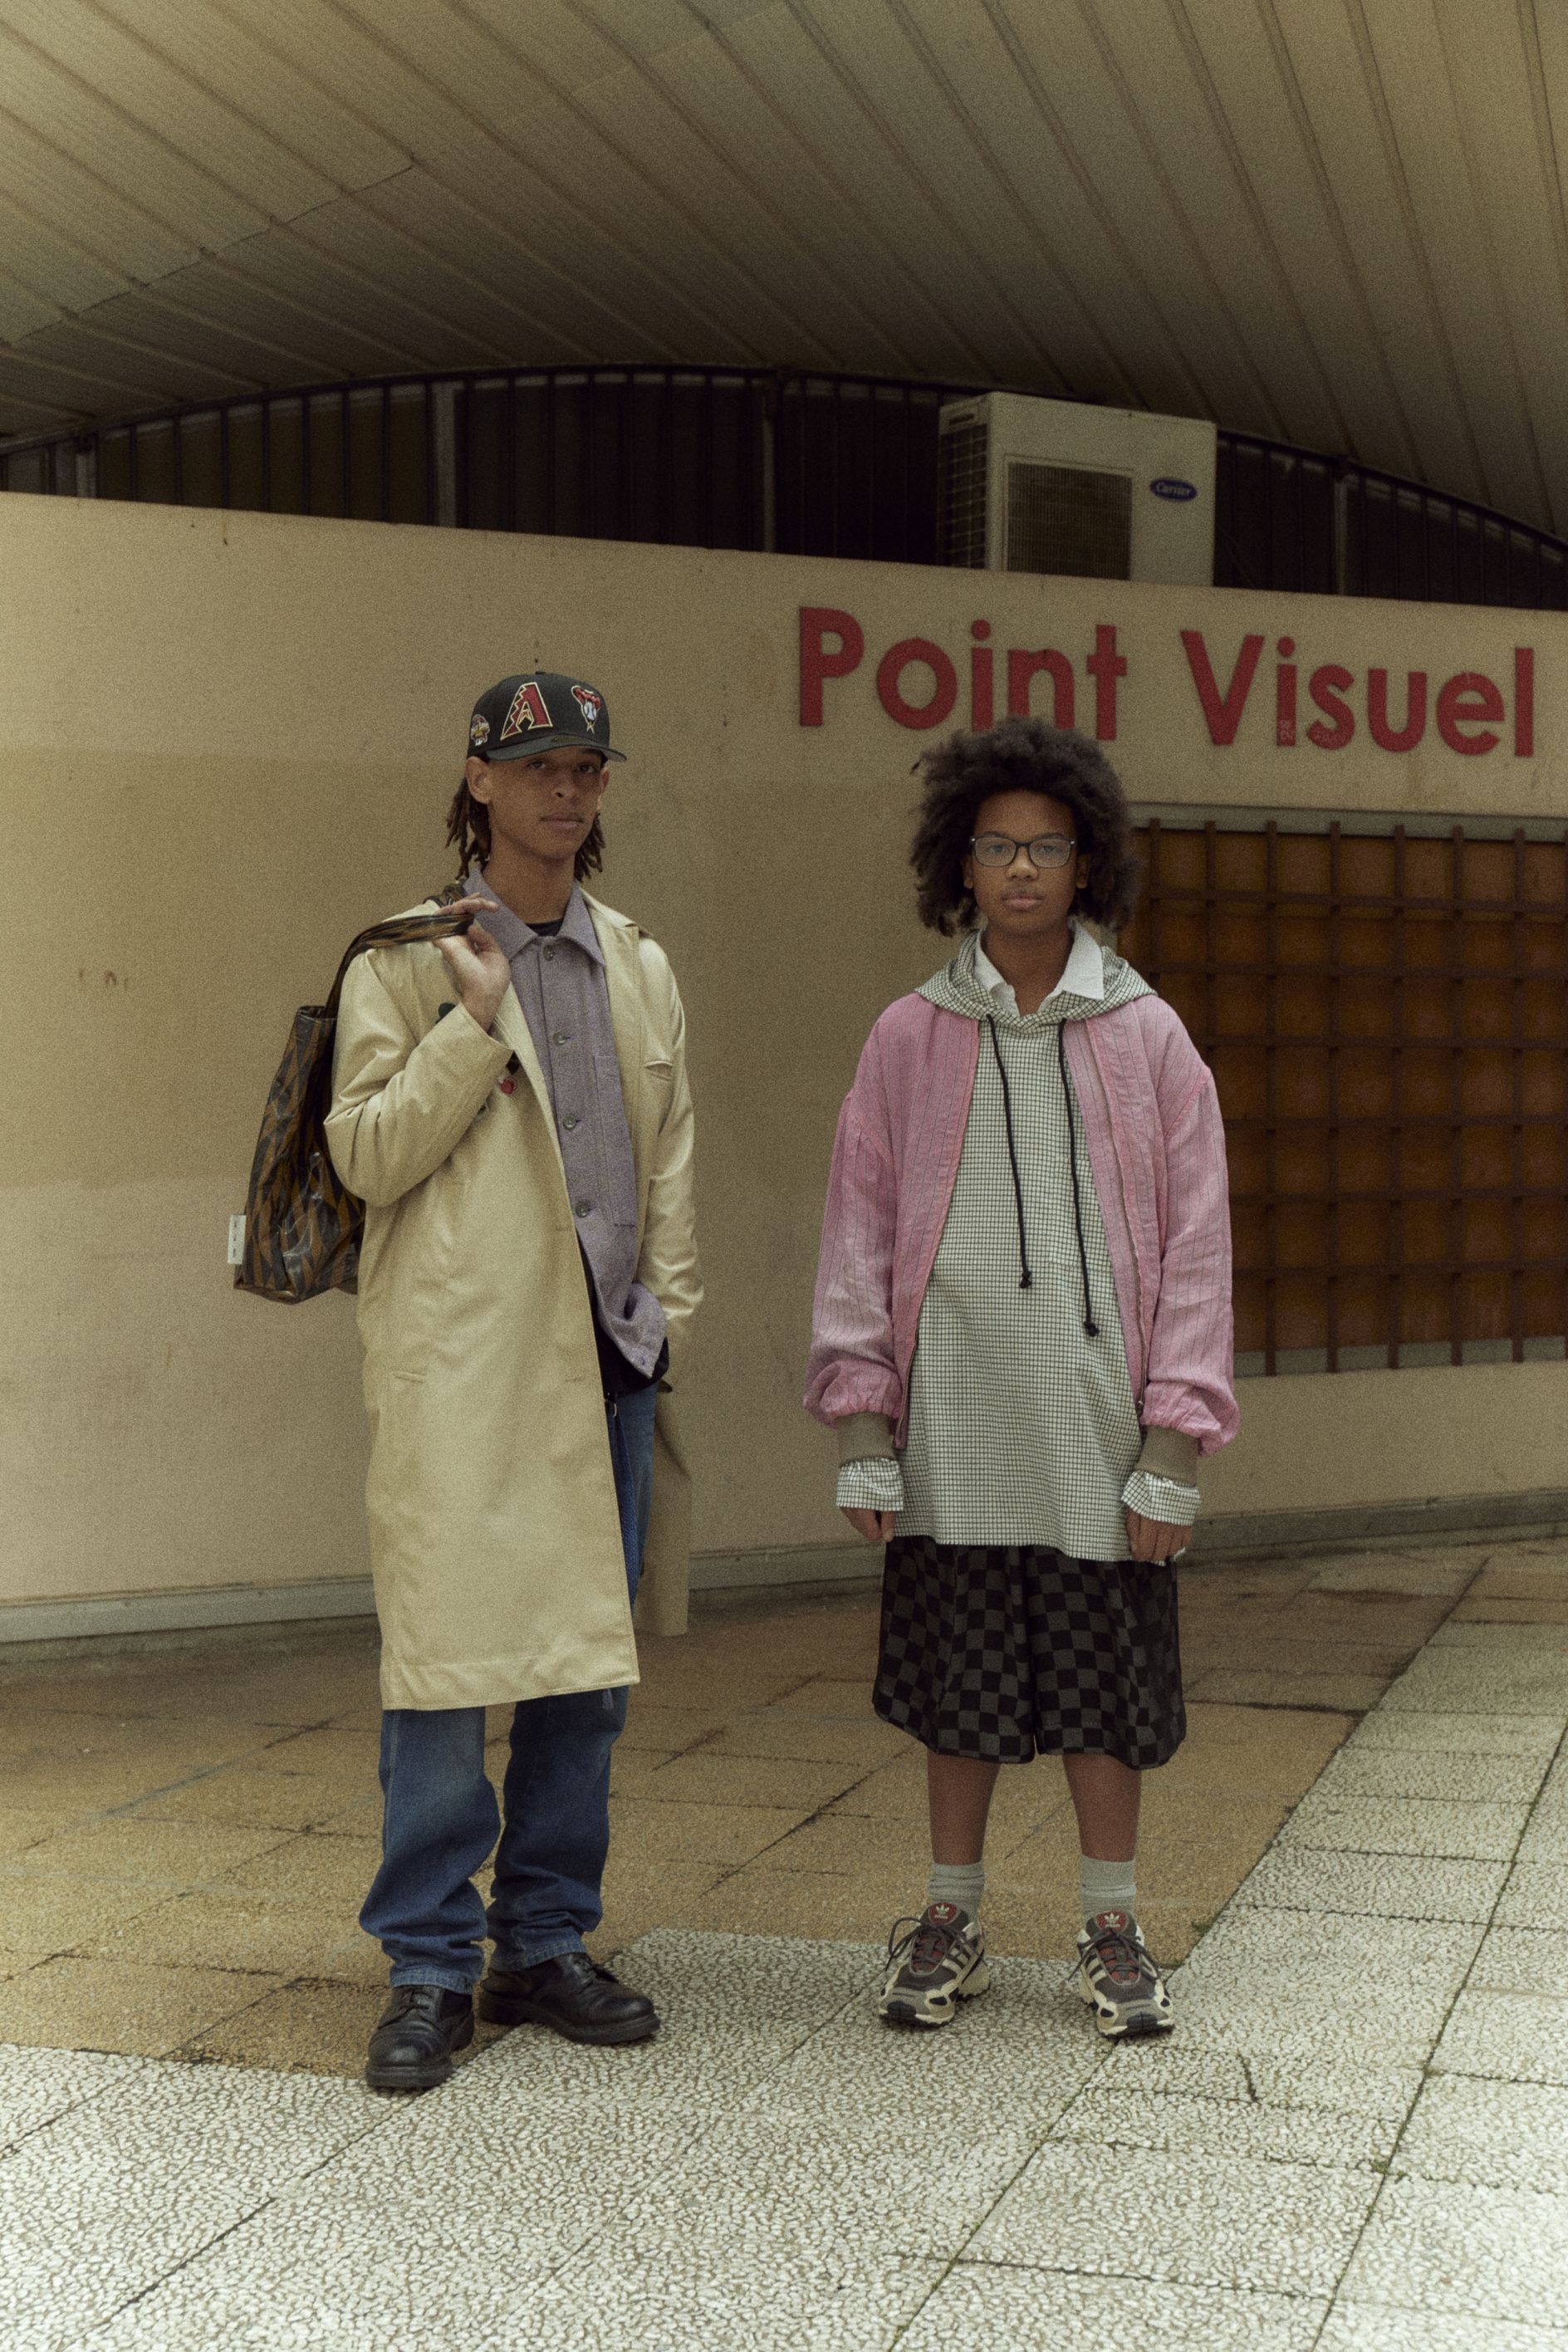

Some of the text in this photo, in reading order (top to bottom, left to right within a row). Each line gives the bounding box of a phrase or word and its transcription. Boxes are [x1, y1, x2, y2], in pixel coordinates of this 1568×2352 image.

[500, 682, 553, 741] A
[799, 606, 1535, 758] Point Visuel
